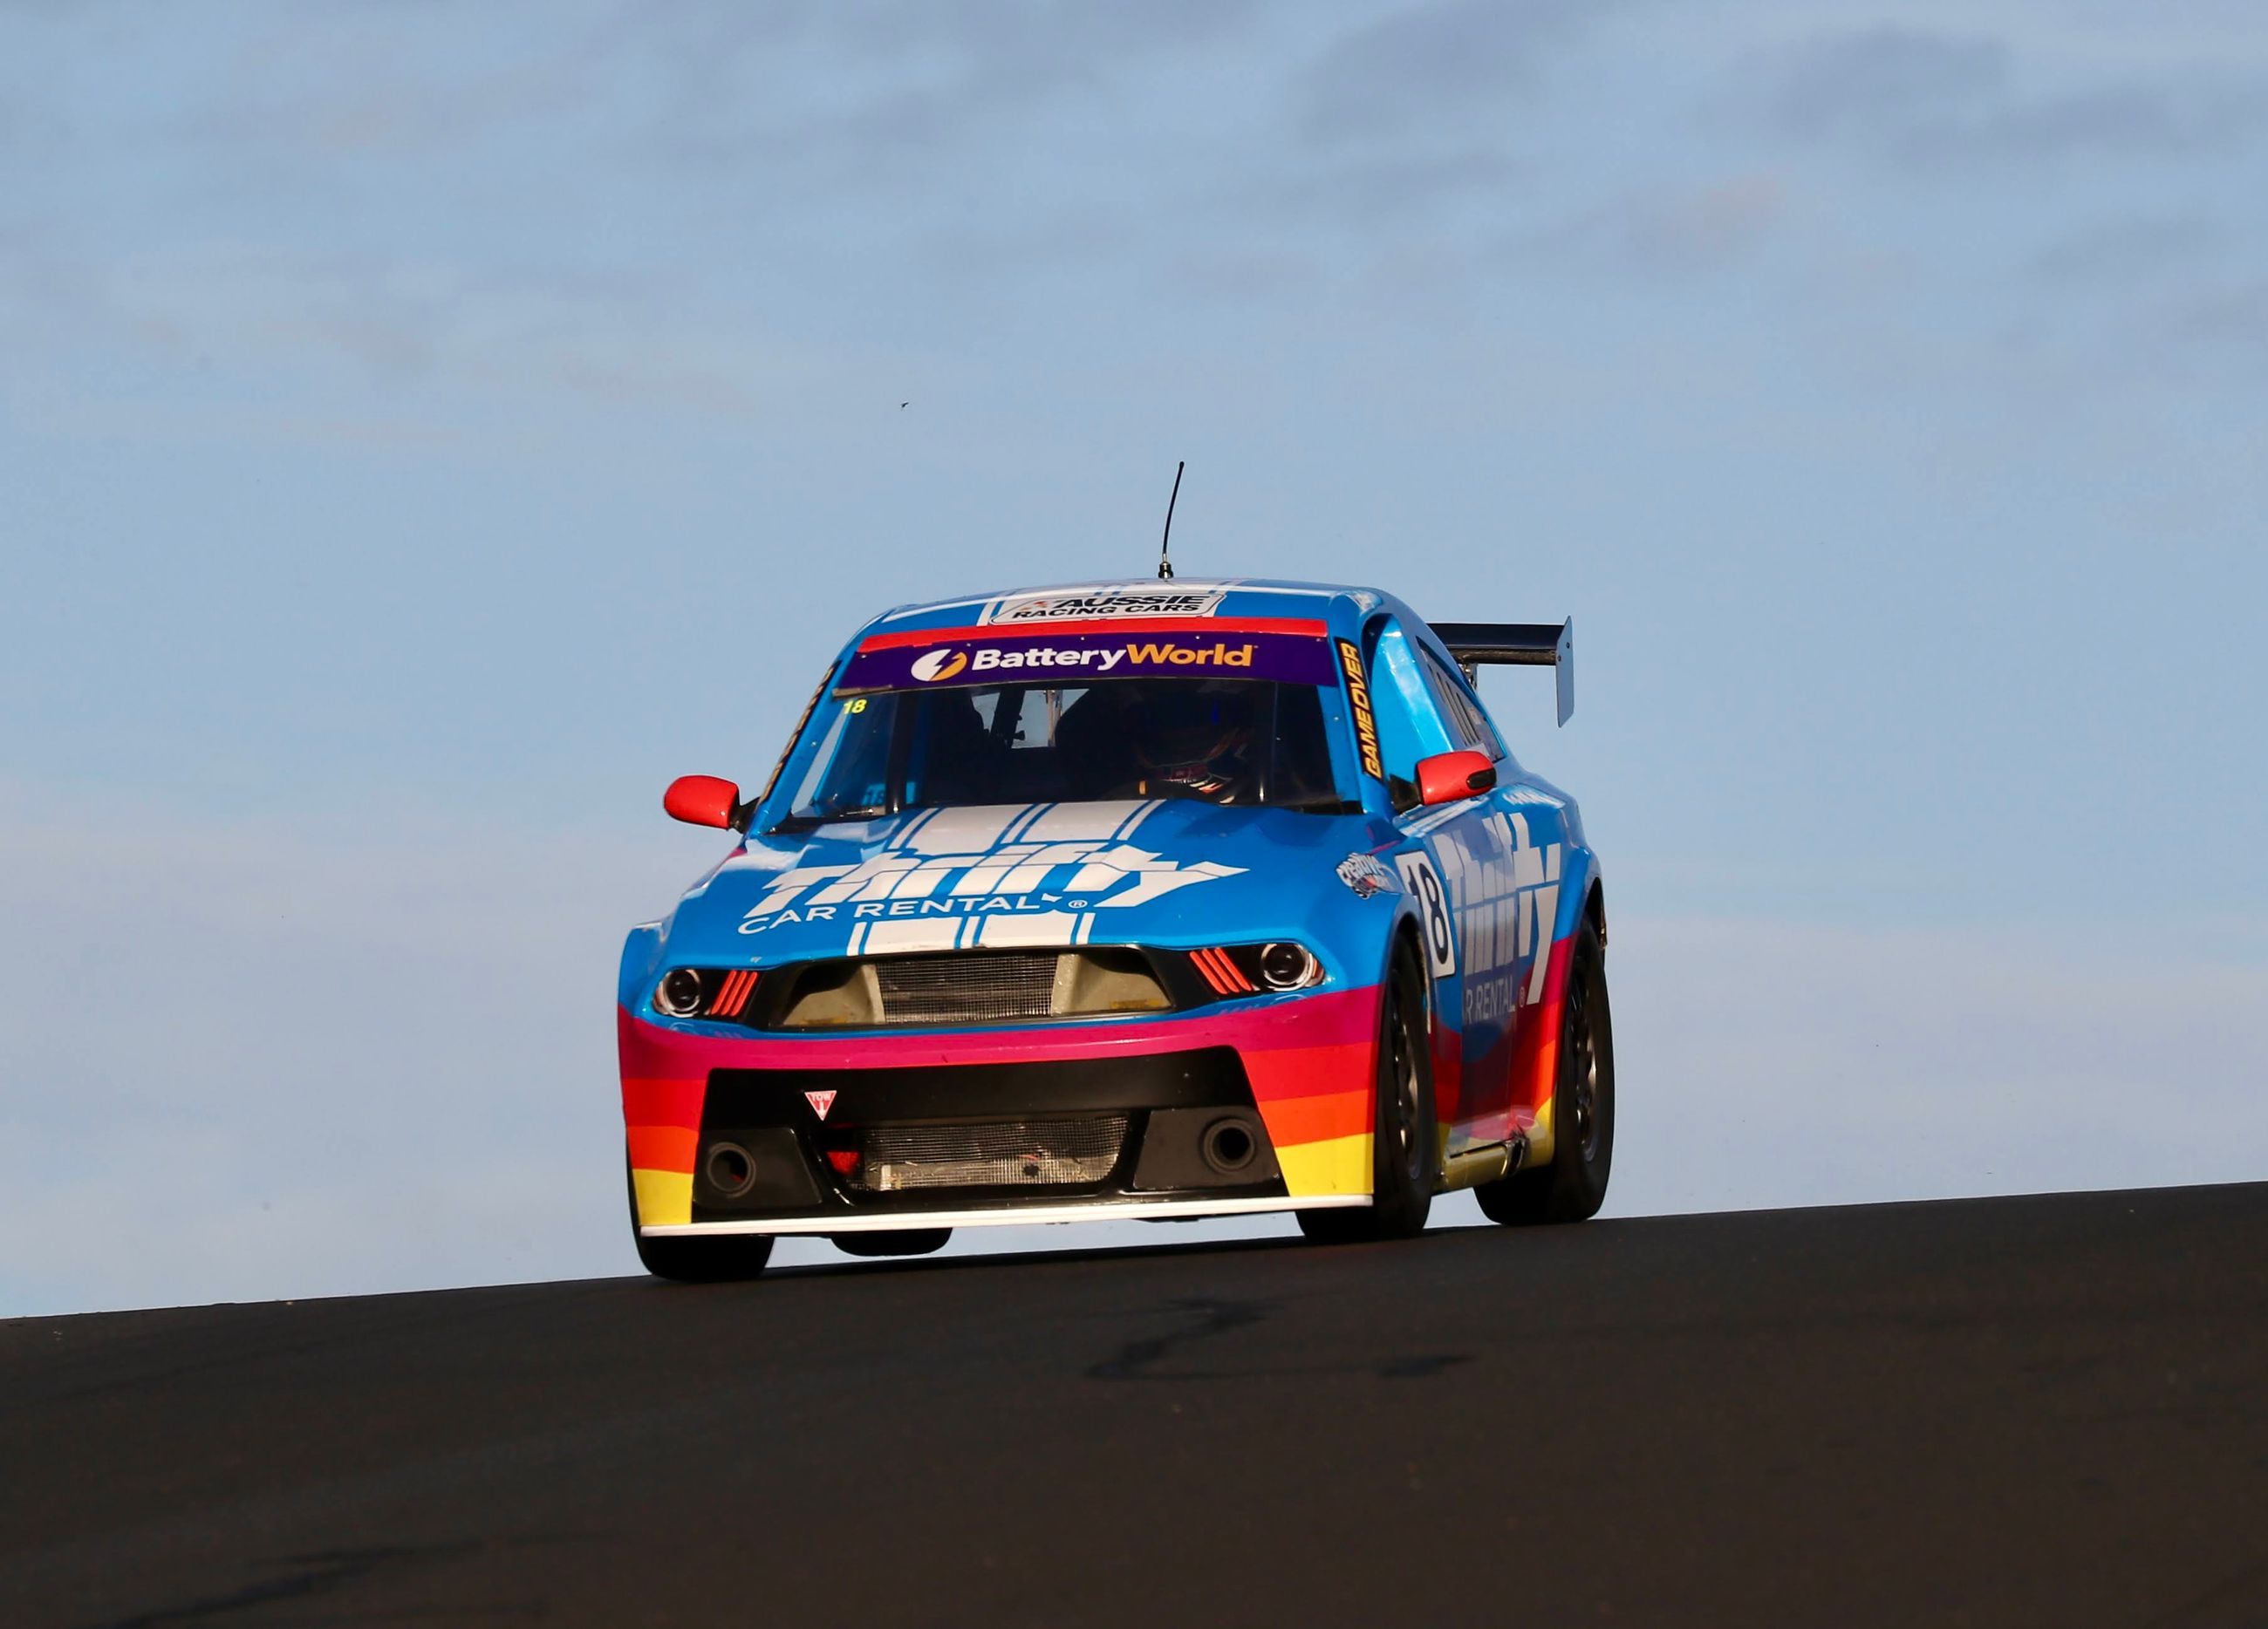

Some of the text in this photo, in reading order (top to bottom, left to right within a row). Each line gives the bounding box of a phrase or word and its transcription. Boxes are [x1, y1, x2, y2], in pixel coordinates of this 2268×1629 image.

[1012, 603, 1200, 619] RACING CARS
[1054, 595, 1211, 609] AUSSIE
[972, 643, 1254, 671] BatteryWorld
[843, 699, 868, 714] 18
[737, 896, 1042, 936] CAR RENTAL
[1406, 861, 1450, 965] 18
